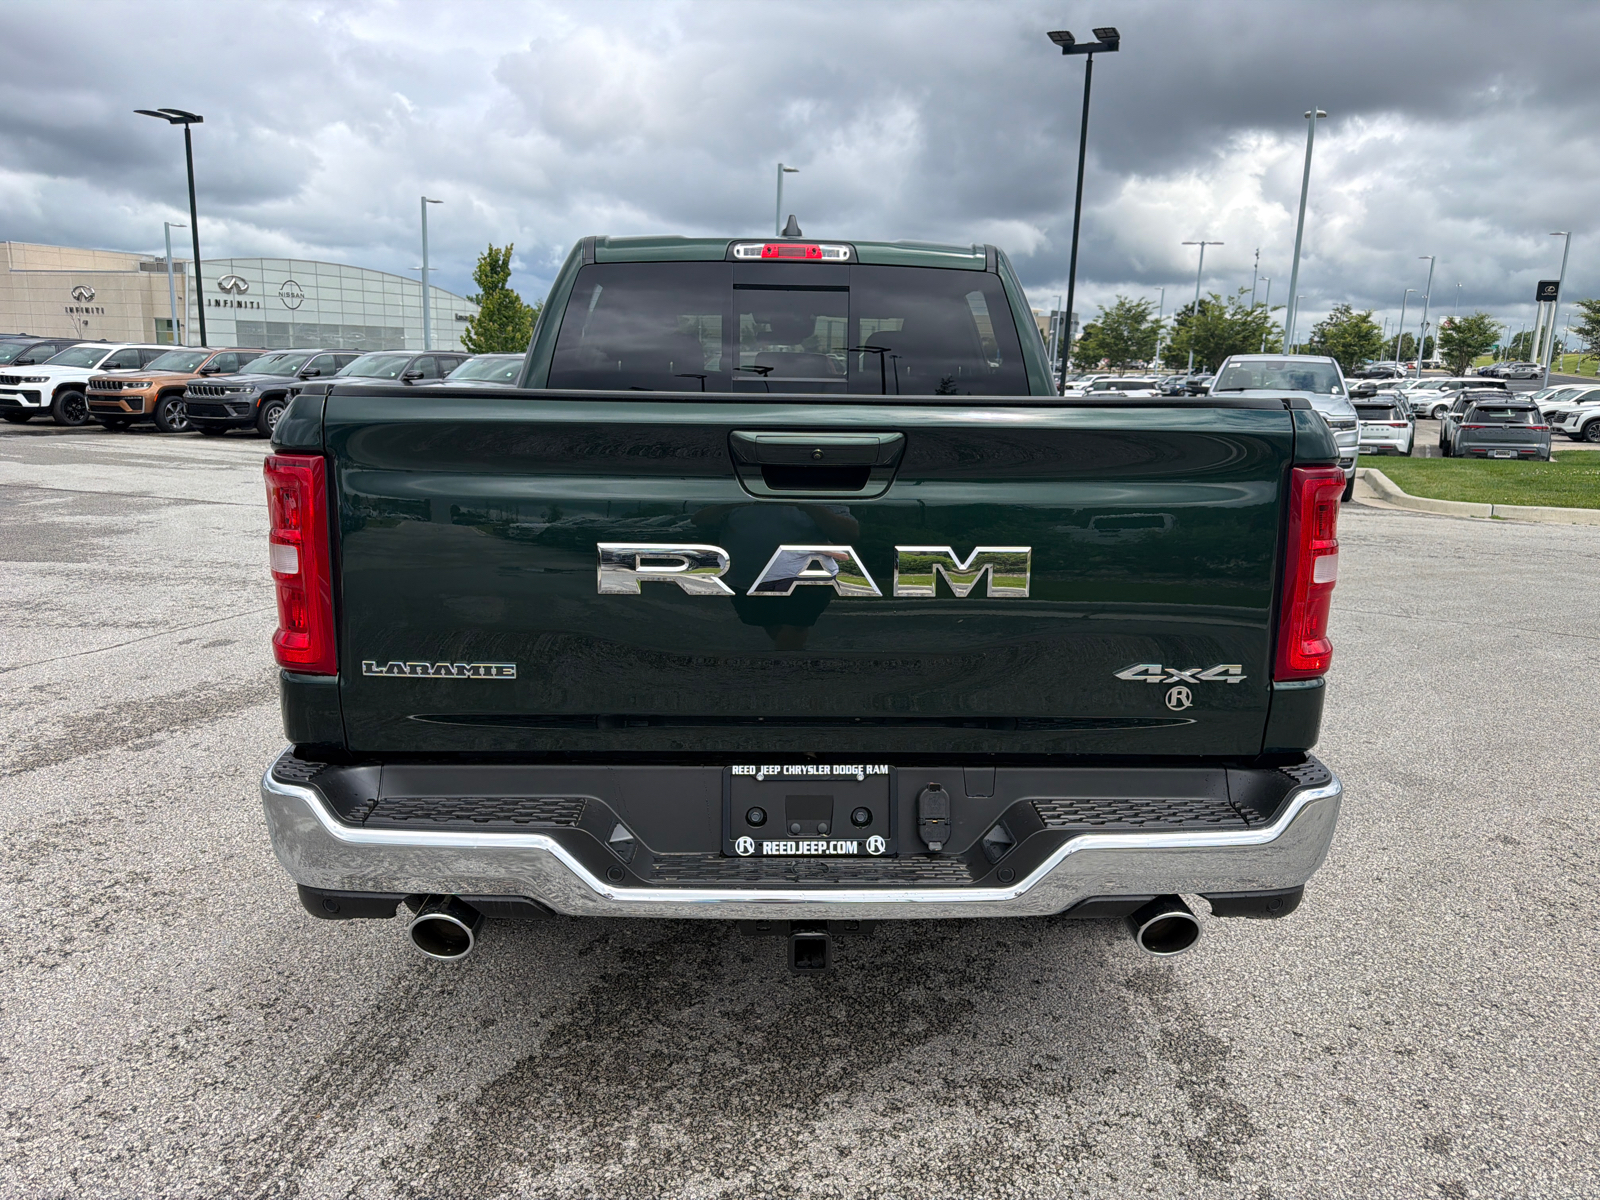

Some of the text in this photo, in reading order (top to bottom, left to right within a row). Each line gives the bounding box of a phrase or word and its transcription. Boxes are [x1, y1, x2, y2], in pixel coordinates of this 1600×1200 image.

[278, 291, 305, 299] NISSAN
[64, 306, 105, 315] INFINITI
[206, 298, 261, 310] INFINITI
[596, 542, 1033, 598] RAM
[362, 660, 517, 679] LARAMIE
[1114, 663, 1248, 684] 4x4
[732, 765, 889, 775] REED JEEP CHRYSLER DODGE RAM
[762, 841, 858, 855] REEDJEEP.COM
